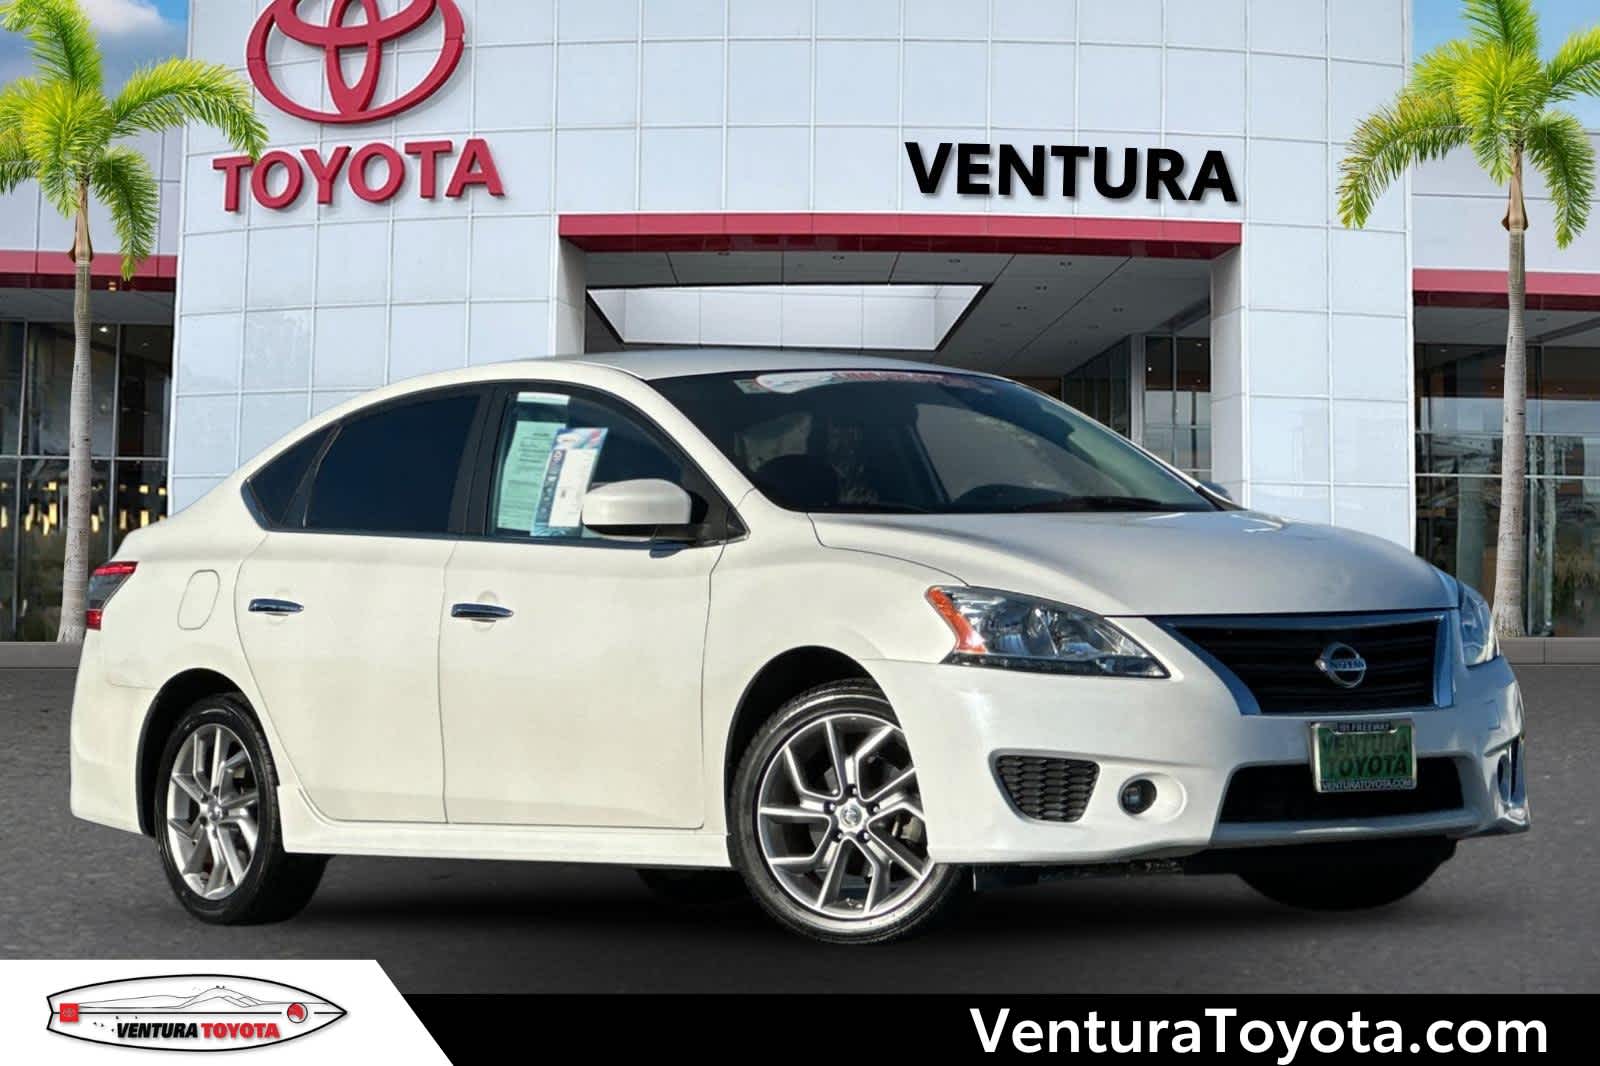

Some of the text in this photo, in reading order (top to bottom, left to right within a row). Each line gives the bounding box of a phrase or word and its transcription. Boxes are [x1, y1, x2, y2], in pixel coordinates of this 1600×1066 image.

[212, 138, 505, 212] TOYOTA
[904, 141, 1238, 203] VENTURA
[1320, 733, 1408, 754] VENTURA
[1327, 755, 1407, 776] TOYOTA
